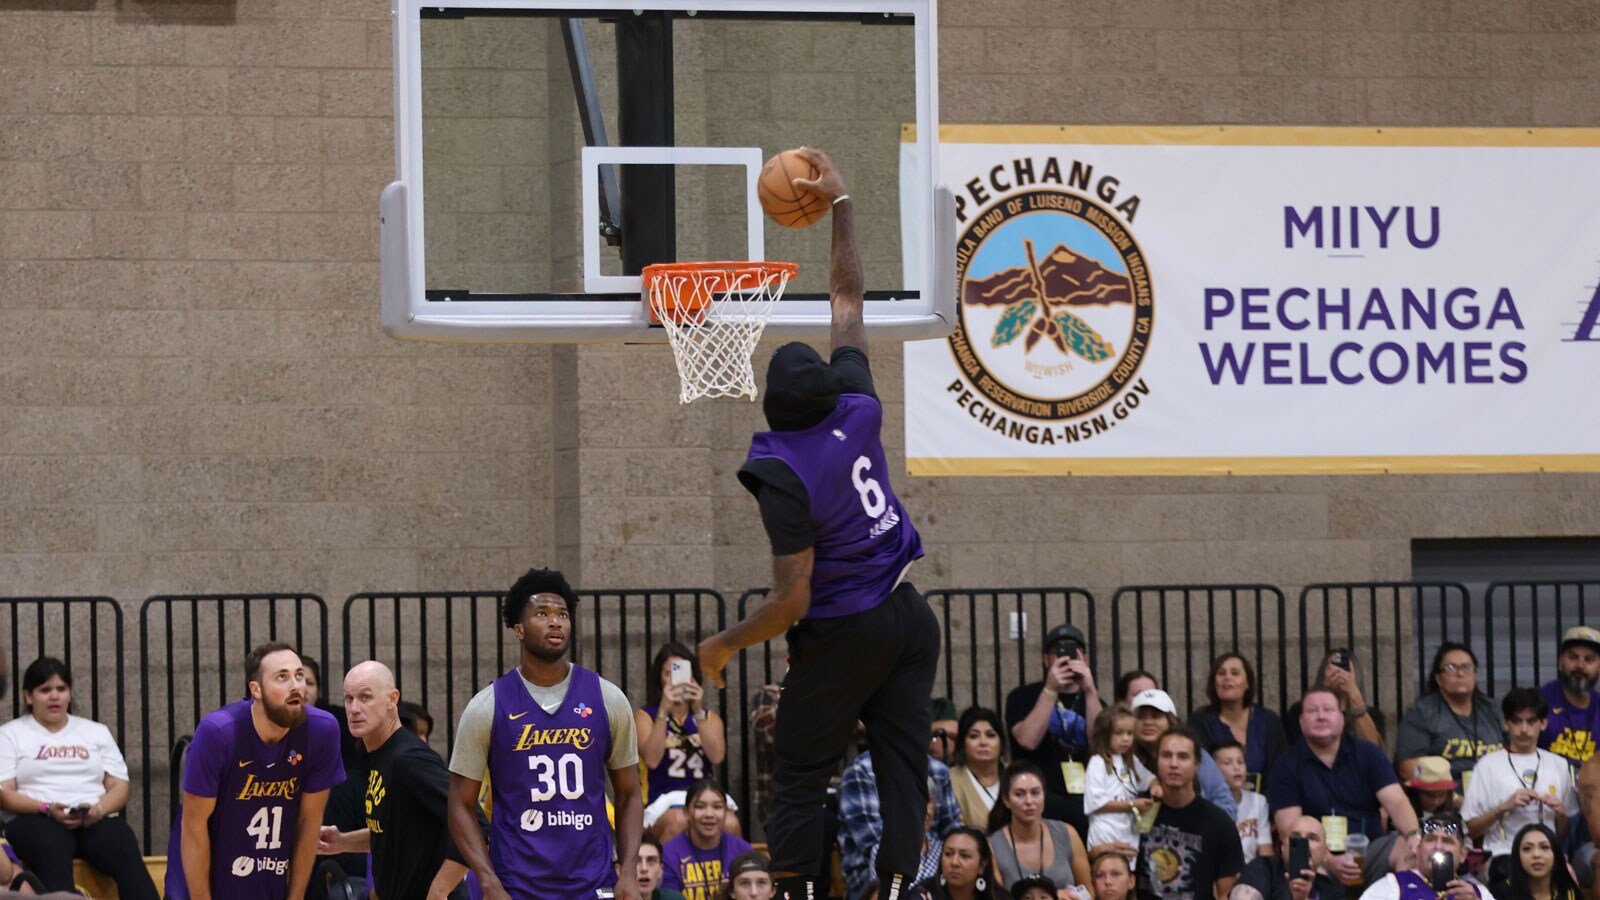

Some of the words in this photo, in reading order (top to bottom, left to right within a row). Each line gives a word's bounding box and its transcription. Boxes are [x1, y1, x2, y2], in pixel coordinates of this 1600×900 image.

[955, 157, 1141, 224] PECHANGA
[972, 209, 1004, 237] BAND
[1006, 198, 1023, 215] OF
[1028, 194, 1083, 213] LUISENO
[1086, 206, 1132, 250] MISSION
[1126, 252, 1151, 306] INDIANS
[1283, 205, 1441, 250] MIIYU
[1203, 287, 1525, 332] PECHANGA
[978, 374, 1052, 418] RESERVATION
[1057, 382, 1115, 417] RIVERSIDE
[1112, 338, 1145, 385] COUNTY
[1136, 317, 1151, 334] CA
[1198, 341, 1528, 385] WELCOMES
[946, 378, 1151, 446] PECHANGA-NSN.GOV
[851, 455, 886, 519] 6
[512, 723, 595, 752] LAKERS
[528, 752, 585, 803] 30
[667, 748, 704, 779] 24
[236, 774, 301, 800] LAKERS
[246, 806, 283, 850] 41
[547, 811, 593, 831] bibigo
